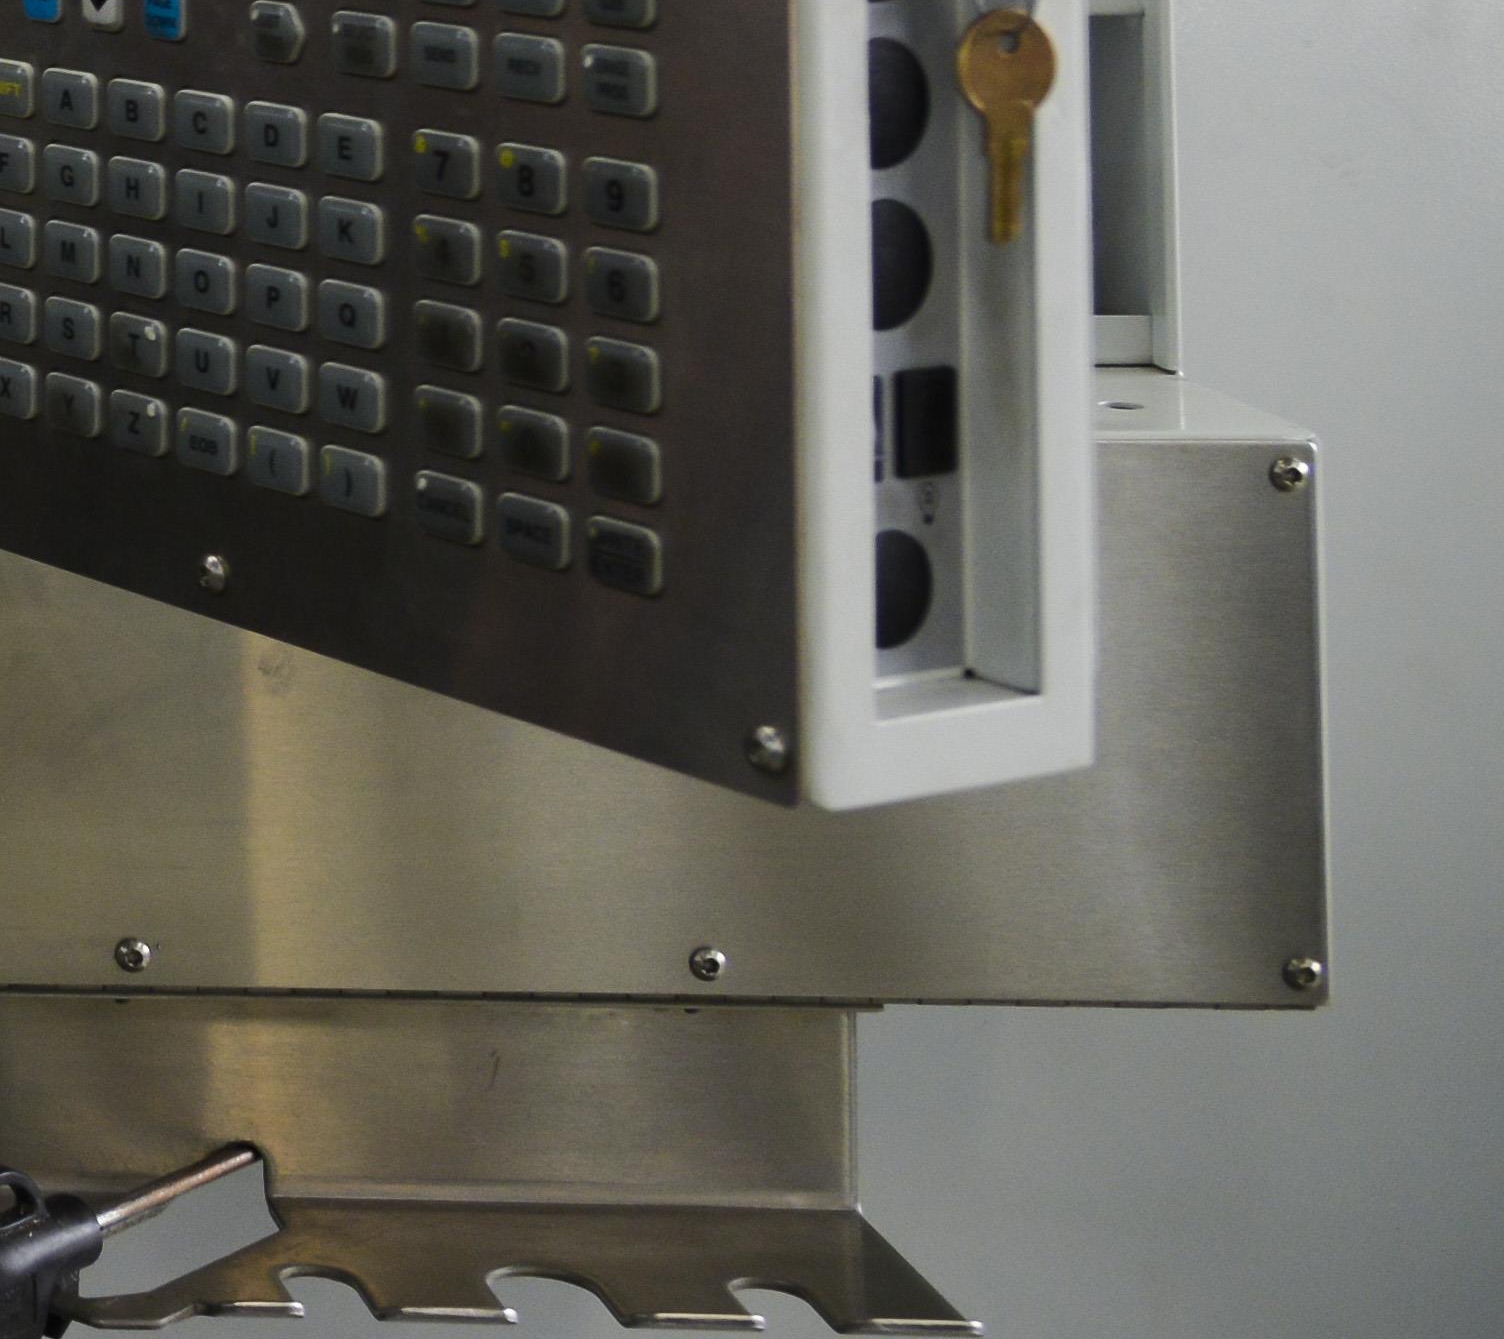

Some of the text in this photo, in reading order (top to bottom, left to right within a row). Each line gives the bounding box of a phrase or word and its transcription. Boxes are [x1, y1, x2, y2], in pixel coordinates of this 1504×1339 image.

[58, 88, 74, 112] A
[125, 98, 139, 123] B
[191, 110, 209, 135] C
[263, 123, 280, 148] D
[336, 135, 353, 161] E
[59, 164, 75, 188] G
[432, 148, 452, 183] 7
[125, 177, 140, 201] H
[515, 162, 536, 199] 8
[604, 177, 625, 214] 9
[266, 205, 279, 229] J
[0, 226, 12, 250] L
[336, 217, 354, 245] K
[60, 239, 76, 264] M
[126, 253, 142, 280] N
[192, 269, 210, 295] O
[605, 267, 627, 304] 6
[265, 284, 281, 310] P
[338, 302, 357, 330] Q
[61, 317, 76, 341] S
[127, 332, 141, 357] T
[193, 349, 210, 374] U
[265, 366, 281, 392] V
[335, 383, 359, 412] W
[127, 410, 141, 436] Z
[188, 433, 219, 457] EOB
